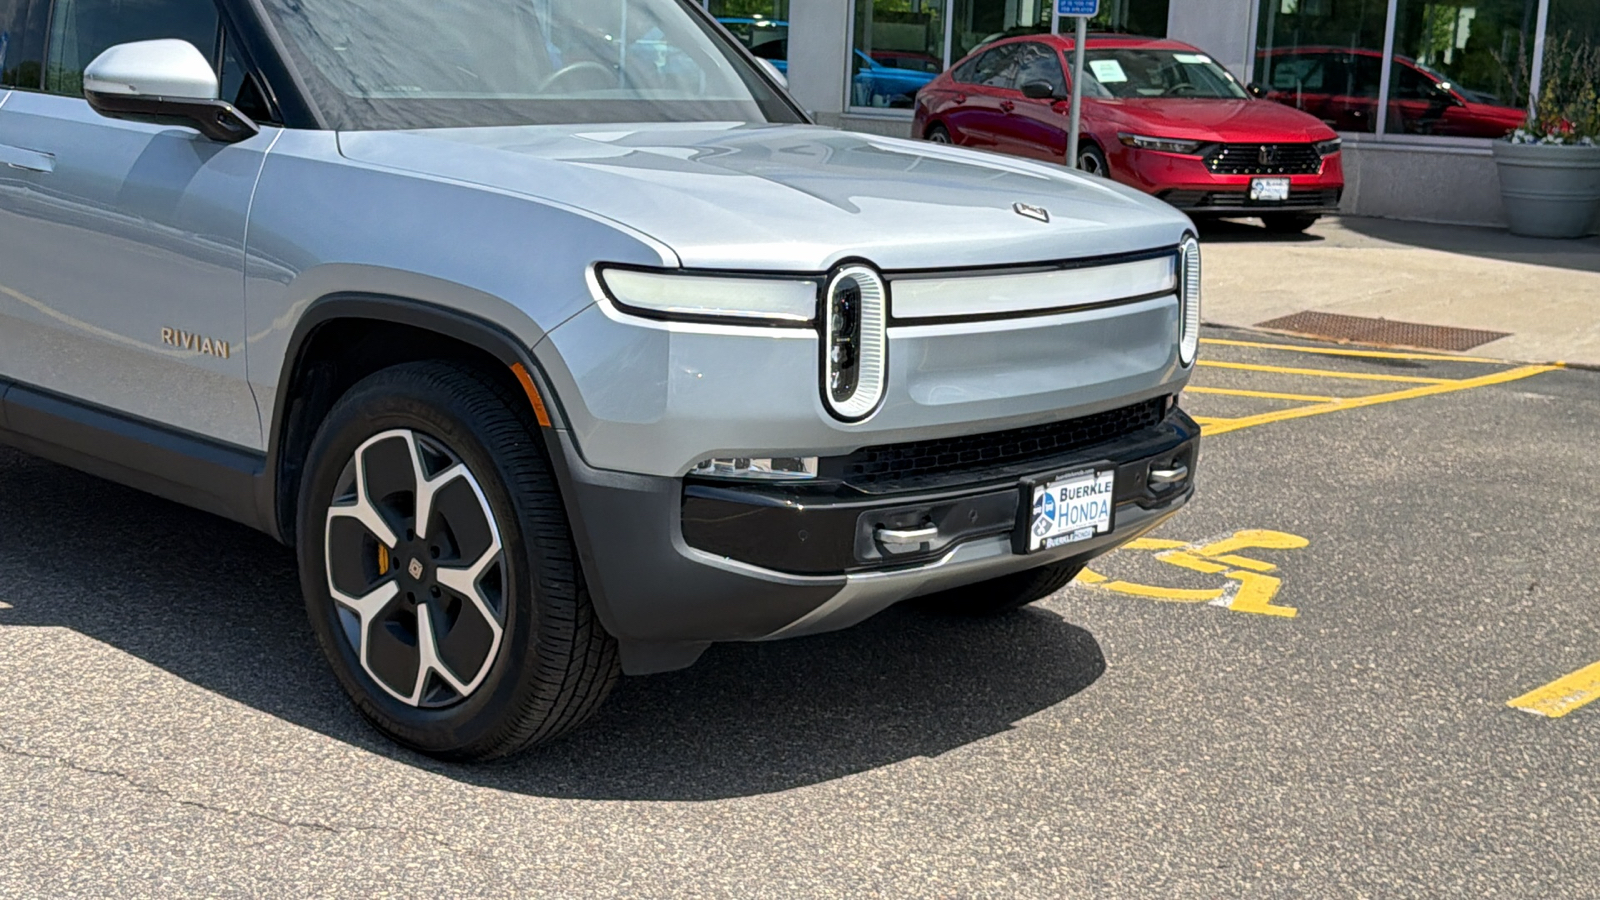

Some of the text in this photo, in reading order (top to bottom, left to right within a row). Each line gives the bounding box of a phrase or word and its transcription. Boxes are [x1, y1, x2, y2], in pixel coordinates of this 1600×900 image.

[161, 326, 230, 360] RIVIAN
[1060, 481, 1111, 502] BUERKLE
[1058, 499, 1108, 528] HONDA
